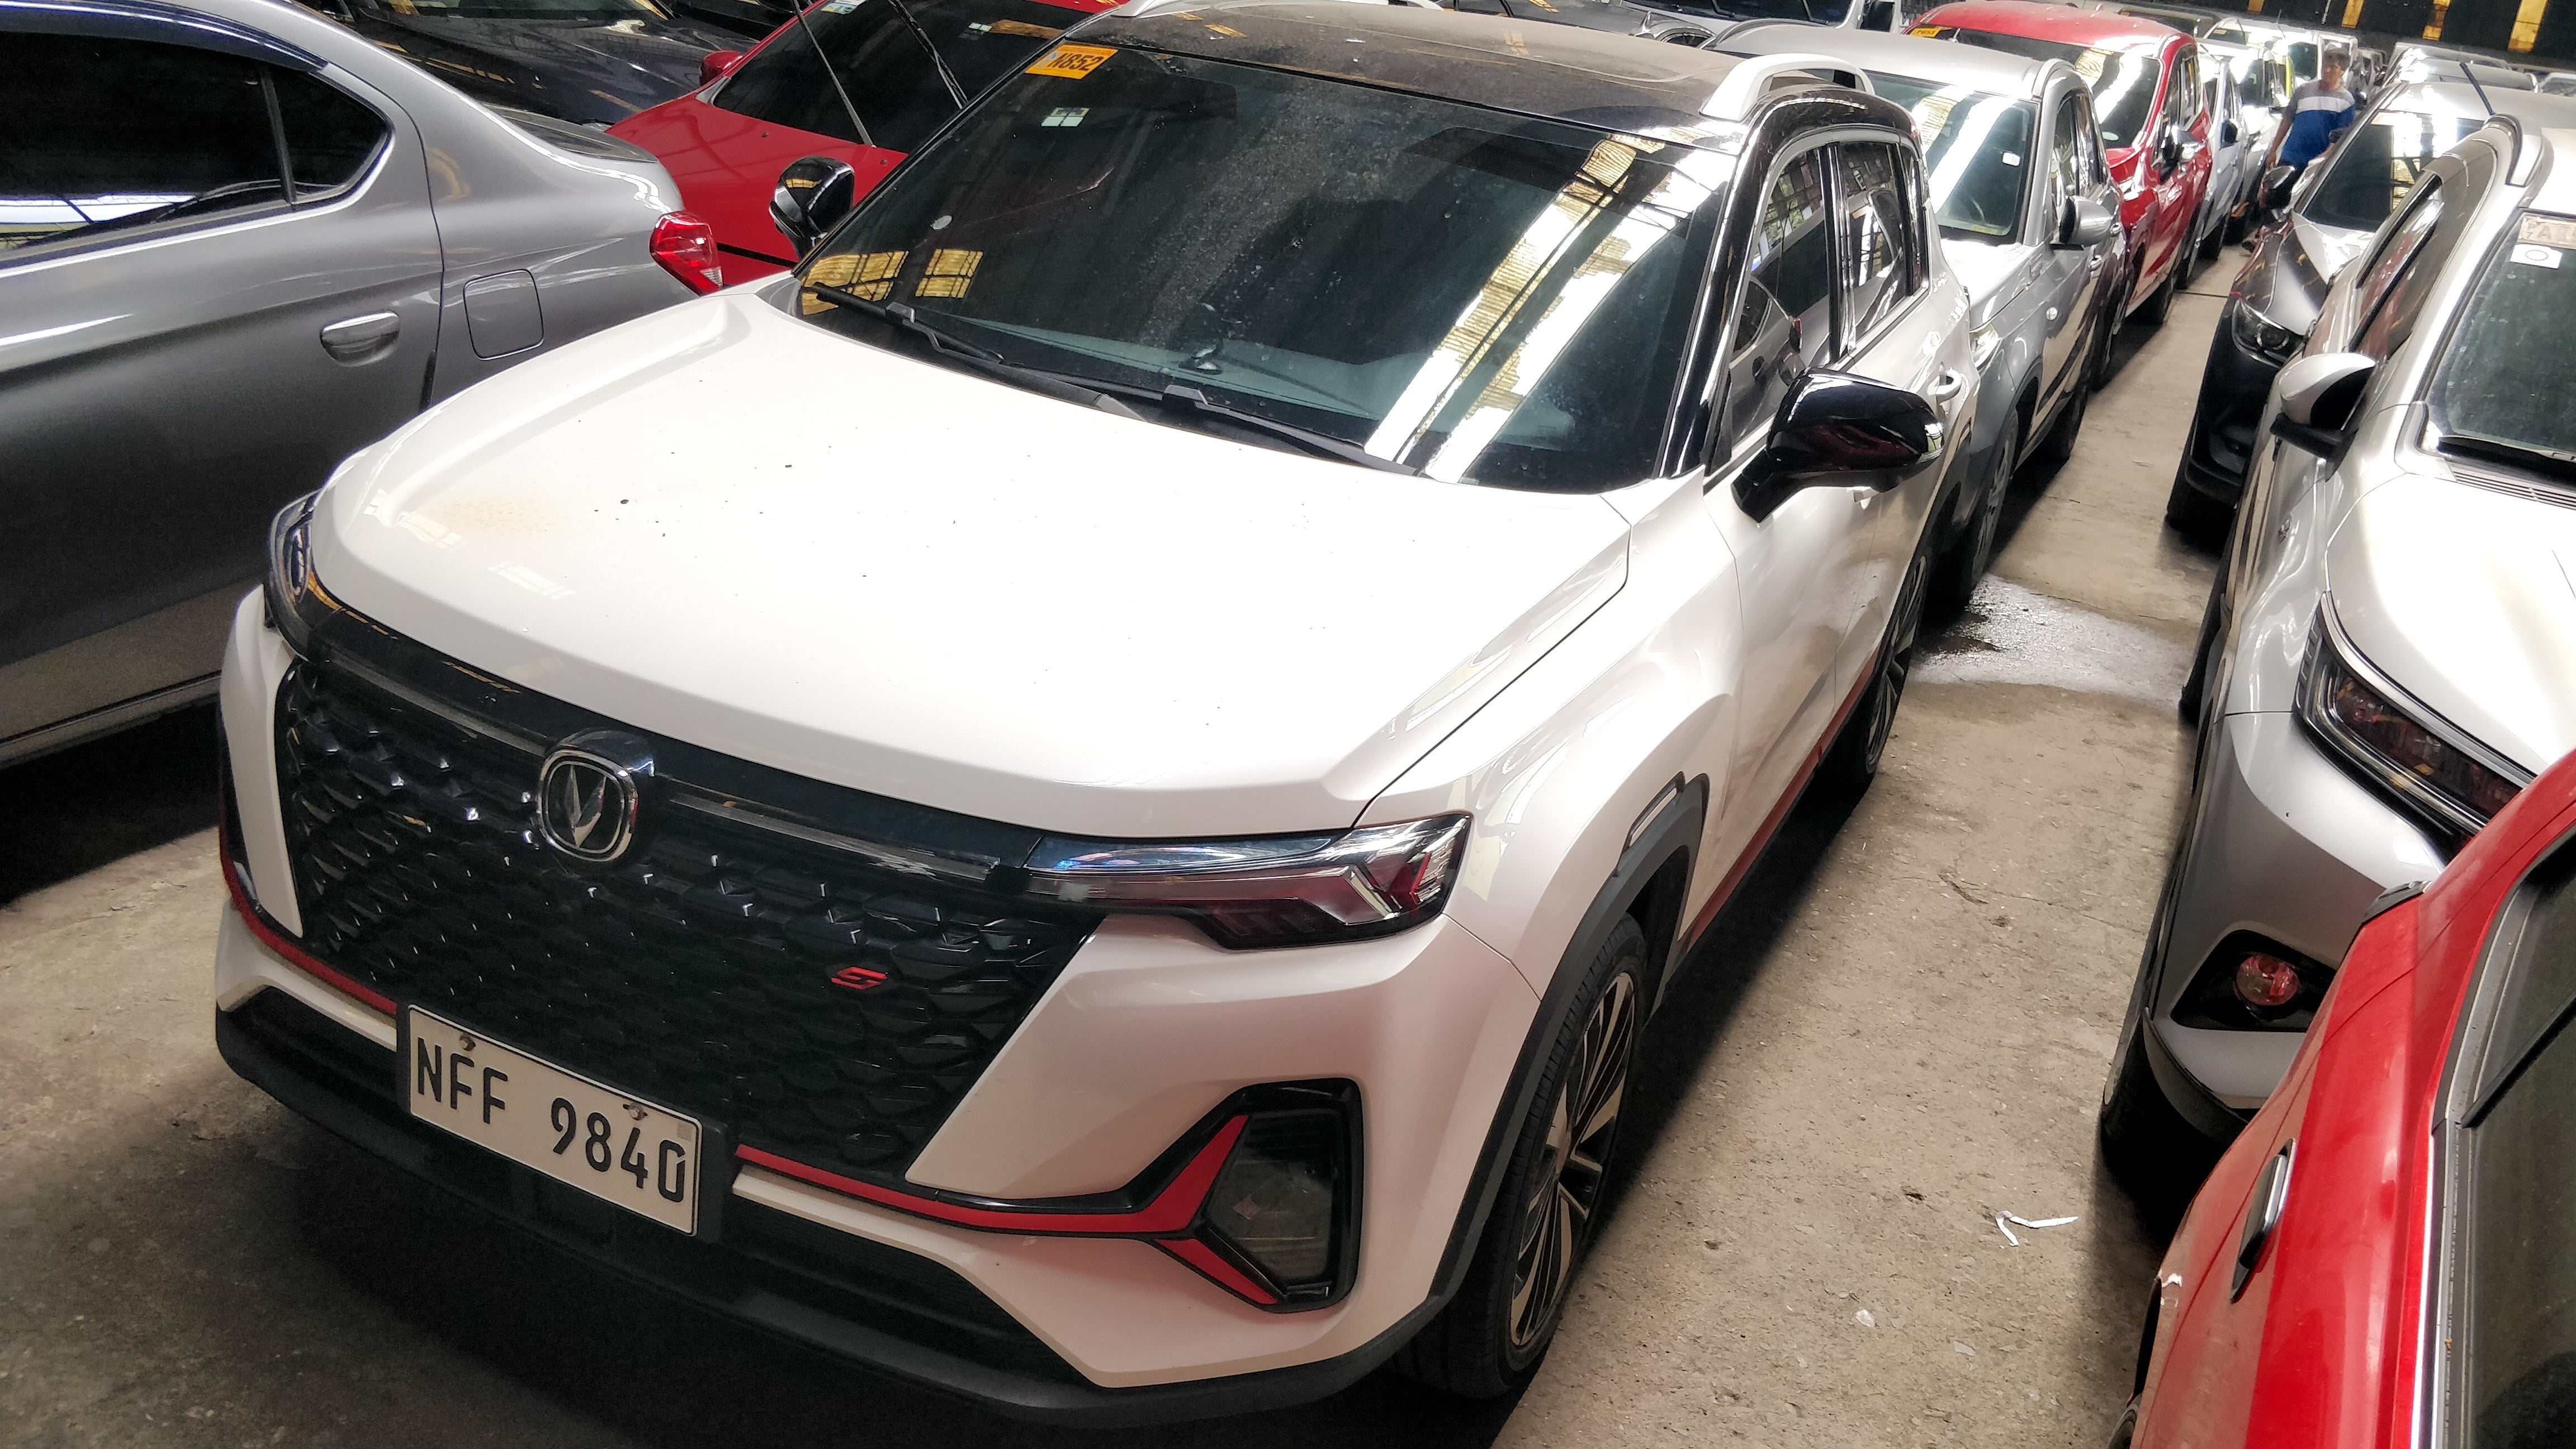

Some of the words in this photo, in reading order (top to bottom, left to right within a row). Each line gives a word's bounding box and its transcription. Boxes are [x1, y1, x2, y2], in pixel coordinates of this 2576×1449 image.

[1047, 53, 1104, 72] N852
[416, 1037, 508, 1124] NFF
[551, 1097, 686, 1202] 9840
